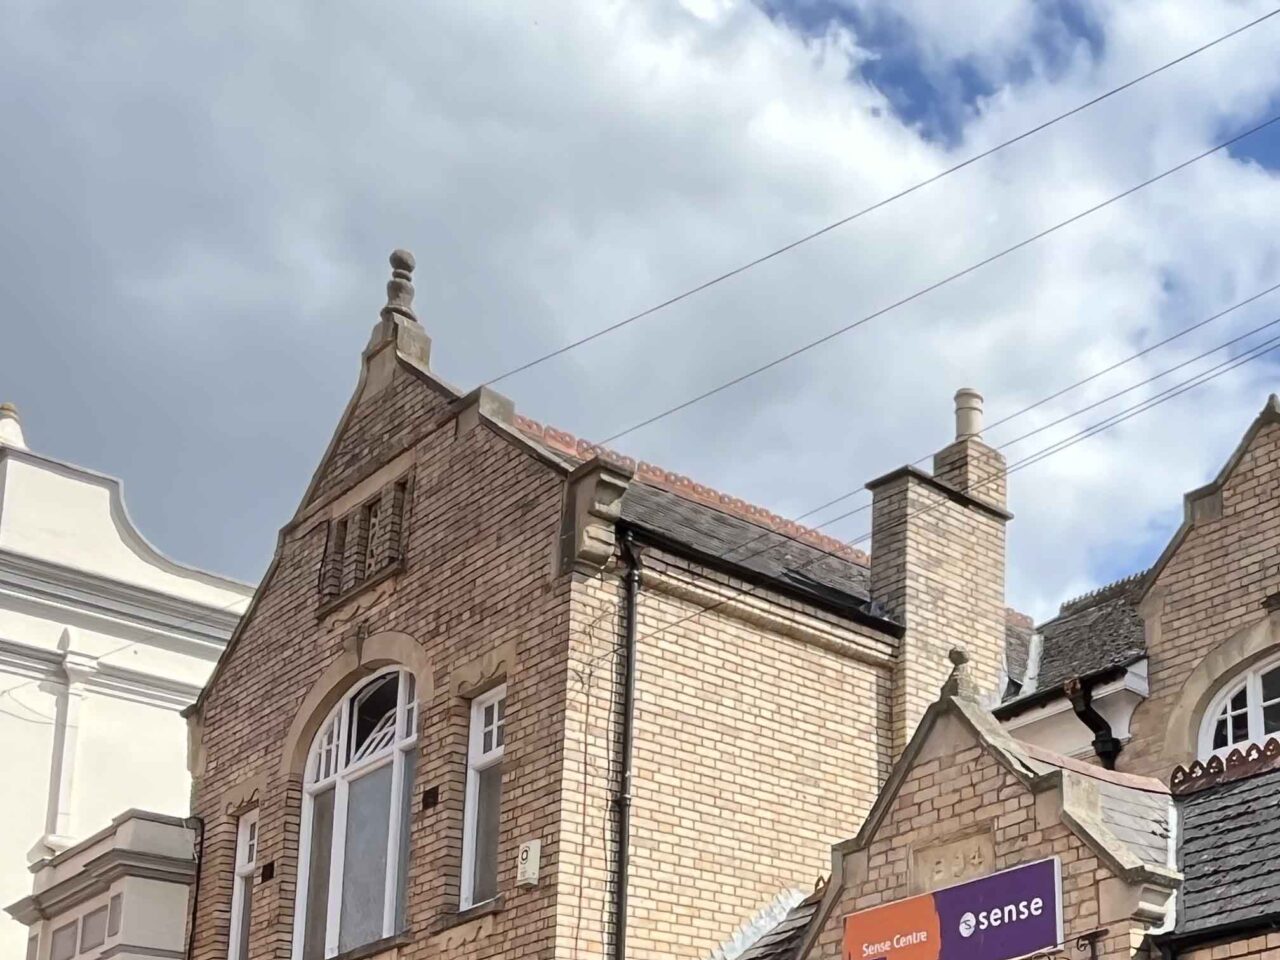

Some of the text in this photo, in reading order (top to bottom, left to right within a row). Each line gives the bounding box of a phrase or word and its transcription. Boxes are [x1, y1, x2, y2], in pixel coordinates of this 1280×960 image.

[978, 897, 1043, 930] sense
[862, 931, 927, 957] Sense Centre
